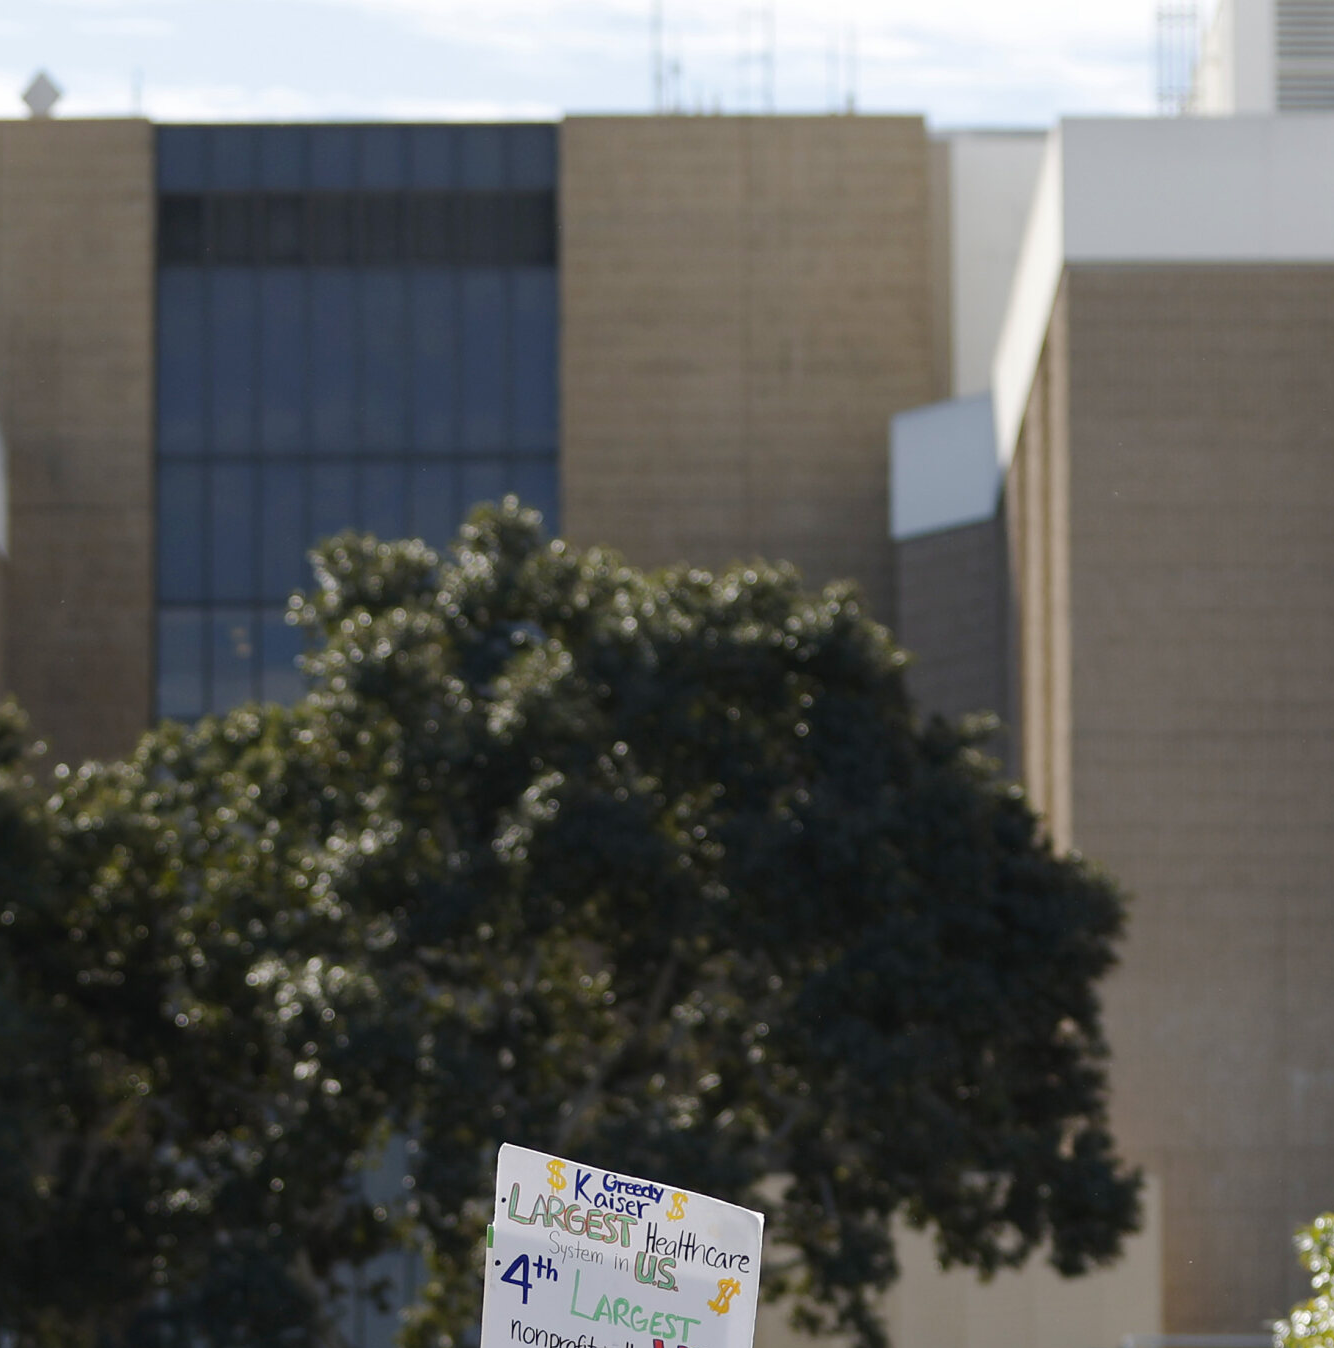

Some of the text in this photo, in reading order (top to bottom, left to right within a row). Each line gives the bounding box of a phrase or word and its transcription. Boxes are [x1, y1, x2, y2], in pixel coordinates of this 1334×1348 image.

[575, 1169, 650, 1219] Kaiser
[603, 1173, 665, 1204] Greedy
[508, 1182, 750, 1273] LARGEST Healthcare
[549, 1231, 603, 1264] System
[614, 1255, 629, 1271] in
[500, 1254, 558, 1304] 4th
[570, 1269, 701, 1342] LARGEST
